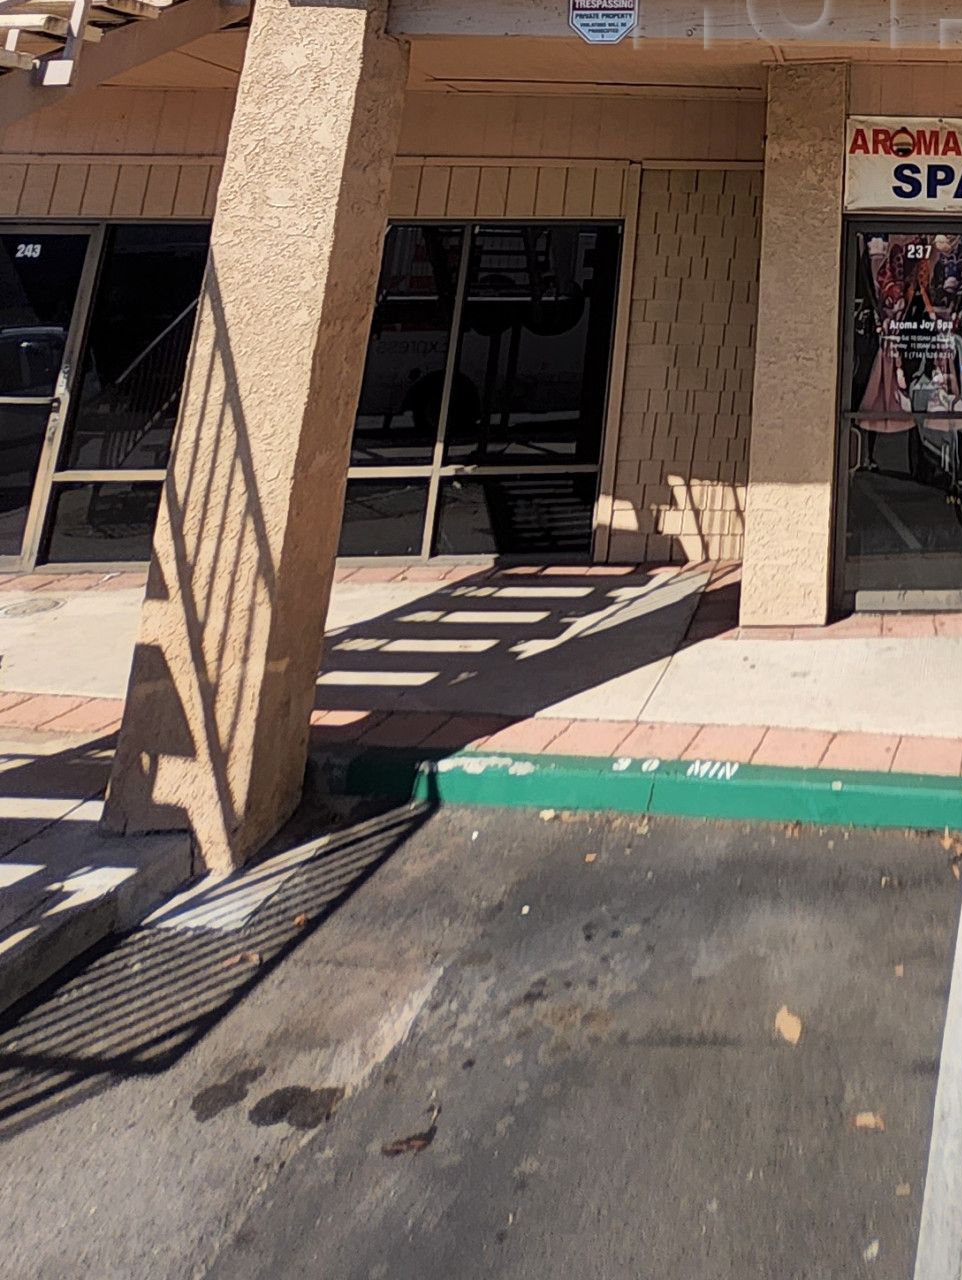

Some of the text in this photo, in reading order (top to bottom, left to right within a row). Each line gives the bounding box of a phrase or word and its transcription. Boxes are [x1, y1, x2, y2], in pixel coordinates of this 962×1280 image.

[574, 0, 634, 9] TRESPASSING
[575, 12, 633, 20] PRIVATE PROPERTY
[849, 127, 962, 158] AROMA
[15, 243, 42, 258] 243
[906, 244, 932, 259] 237
[889, 319, 953, 331] Aroma Joy Spa
[686, 759, 739, 780] MIN
